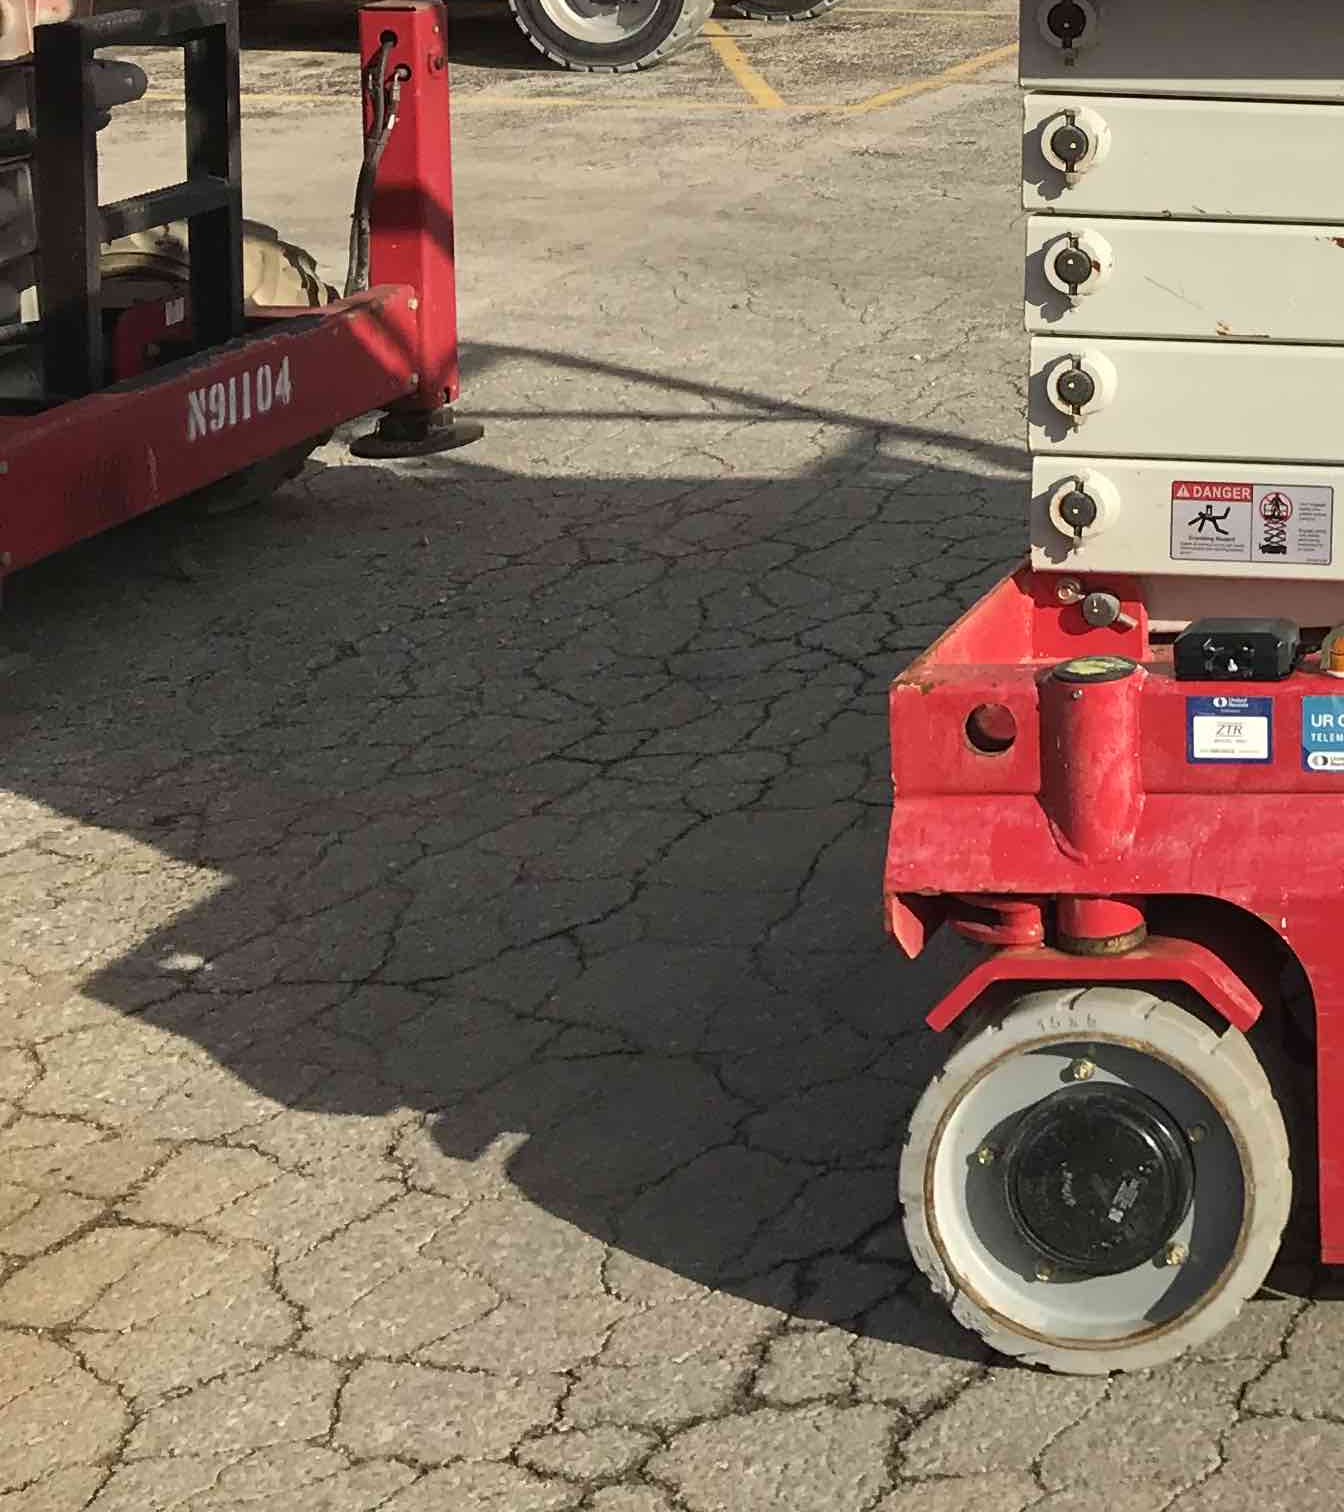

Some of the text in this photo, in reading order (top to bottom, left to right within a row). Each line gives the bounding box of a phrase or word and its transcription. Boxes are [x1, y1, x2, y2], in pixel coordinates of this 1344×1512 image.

[188, 355, 292, 441] N91104
[1193, 485, 1251, 500] DANGER
[1311, 714, 1334, 728] UR
